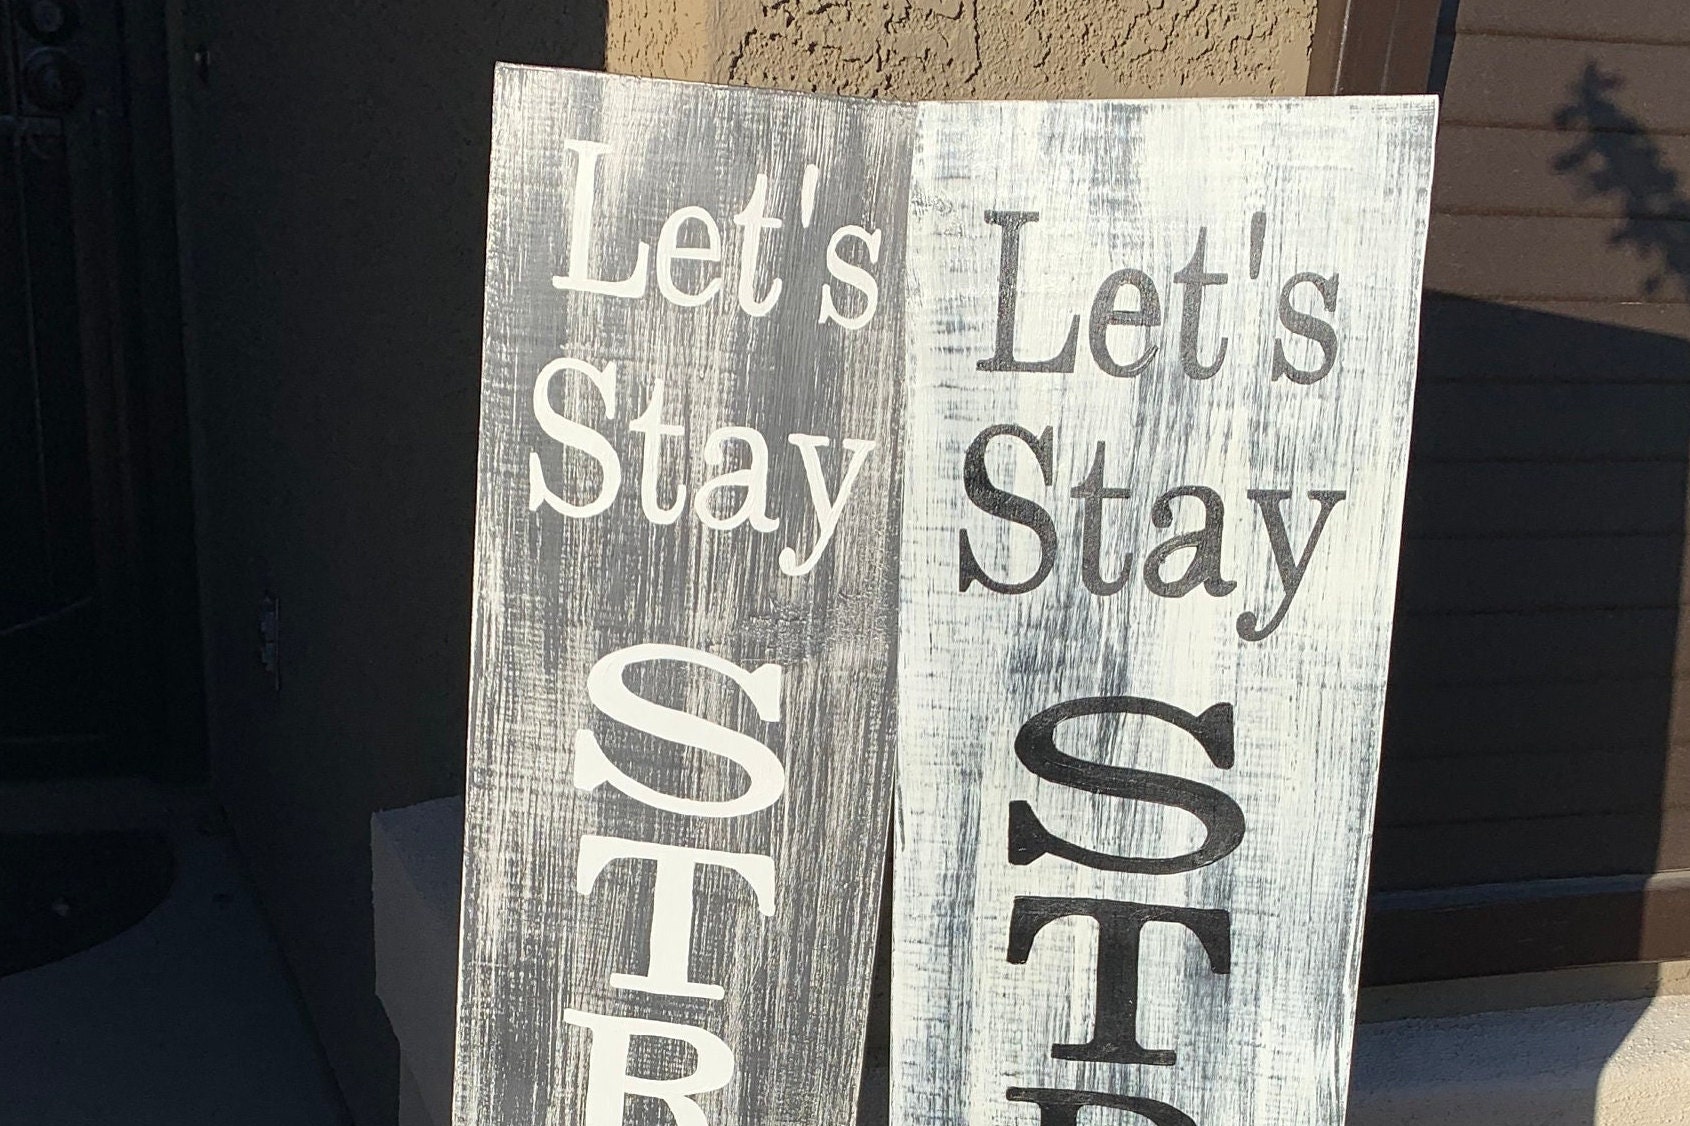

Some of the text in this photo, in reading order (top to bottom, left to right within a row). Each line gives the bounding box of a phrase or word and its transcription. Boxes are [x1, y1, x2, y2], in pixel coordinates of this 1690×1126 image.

[551, 138, 882, 331] Let's
[977, 210, 1339, 385] Let's
[529, 357, 875, 577] Stay
[959, 425, 1346, 641] Stay
